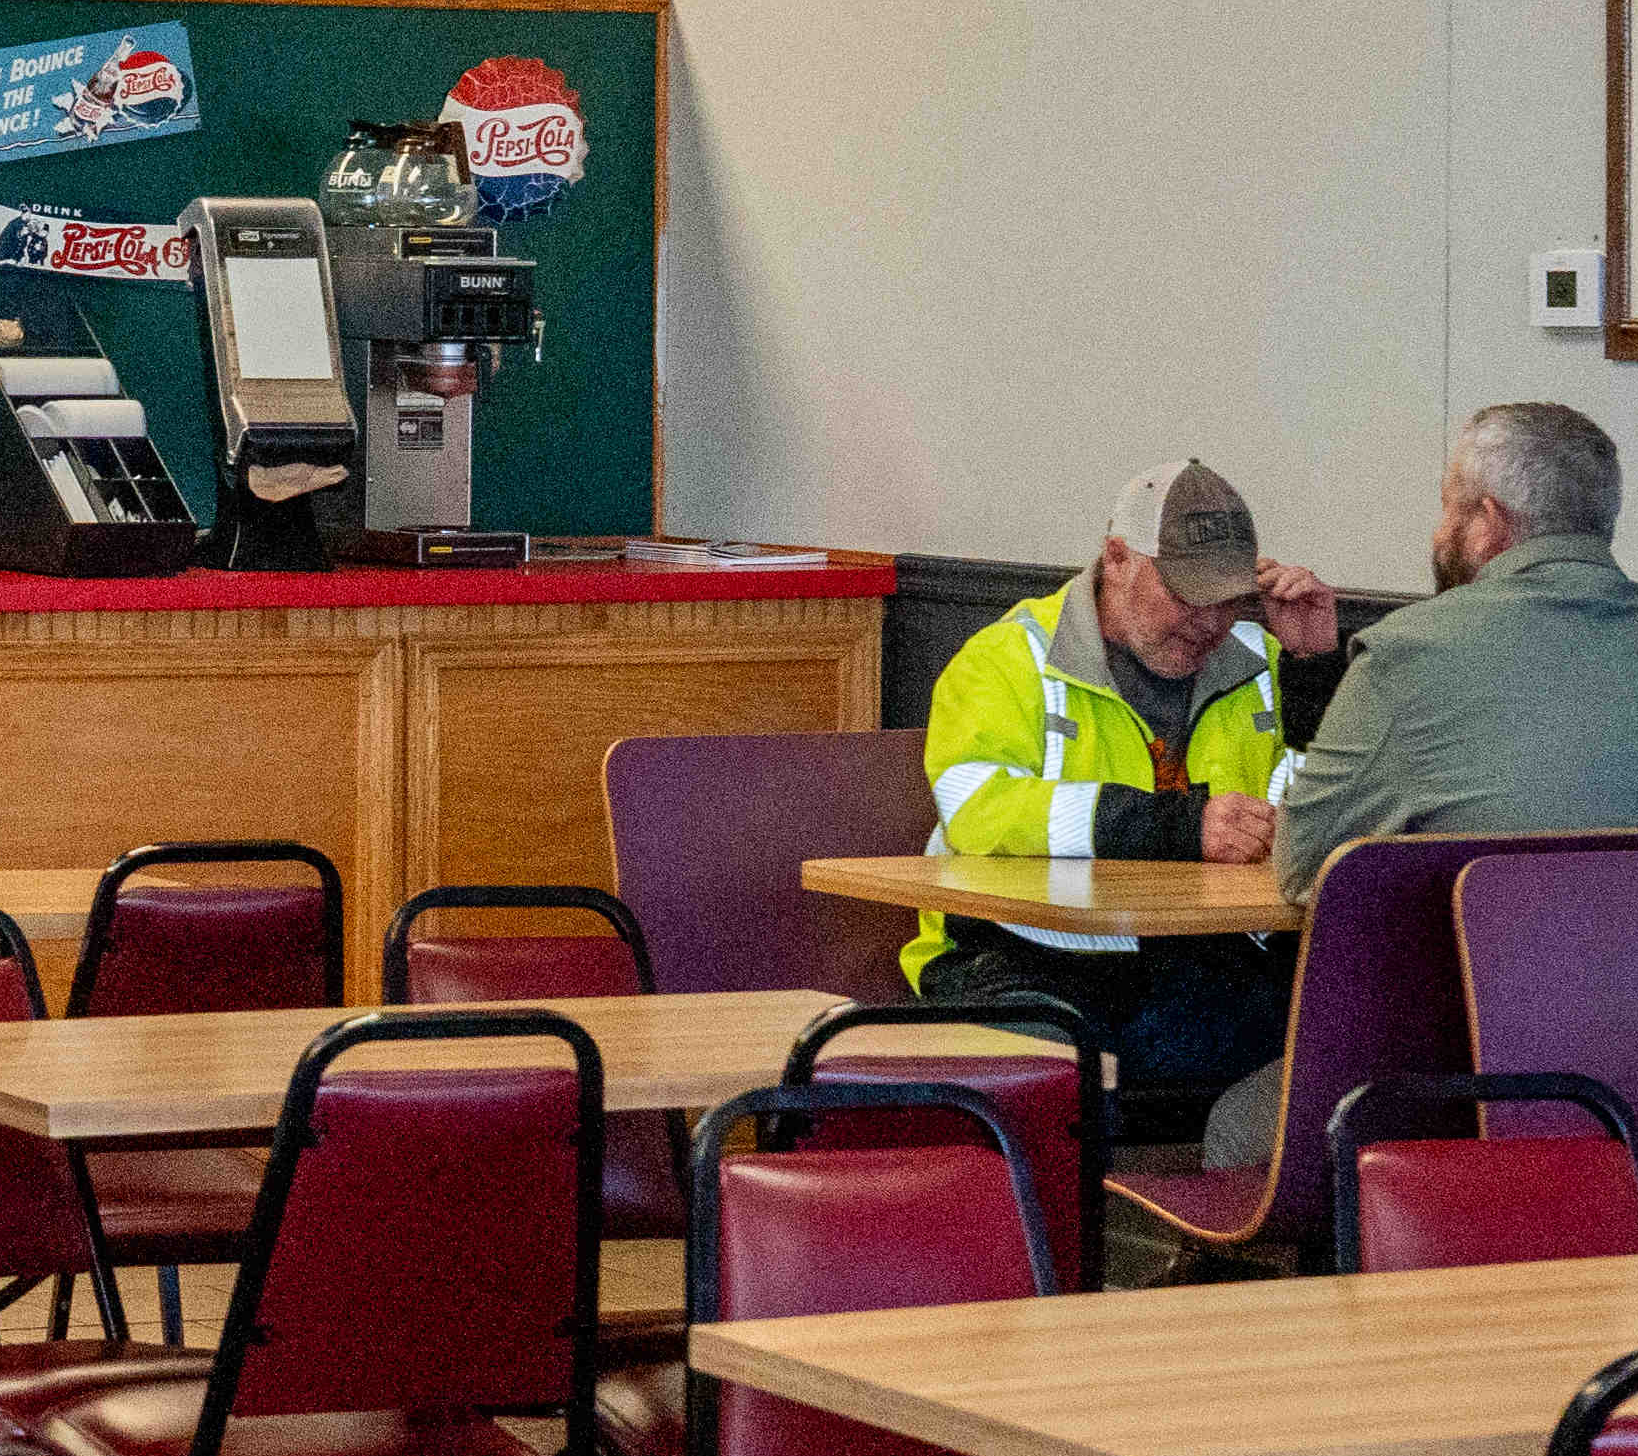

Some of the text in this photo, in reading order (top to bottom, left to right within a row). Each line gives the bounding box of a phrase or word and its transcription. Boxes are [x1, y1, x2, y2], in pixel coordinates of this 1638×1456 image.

[9, 45, 85, 83] BOUNCE
[2, 84, 35, 110] THE
[469, 115, 576, 168] PEPSI-COLA
[32, 203, 83, 218] DRINK
[460, 276, 503, 288] BUNN
